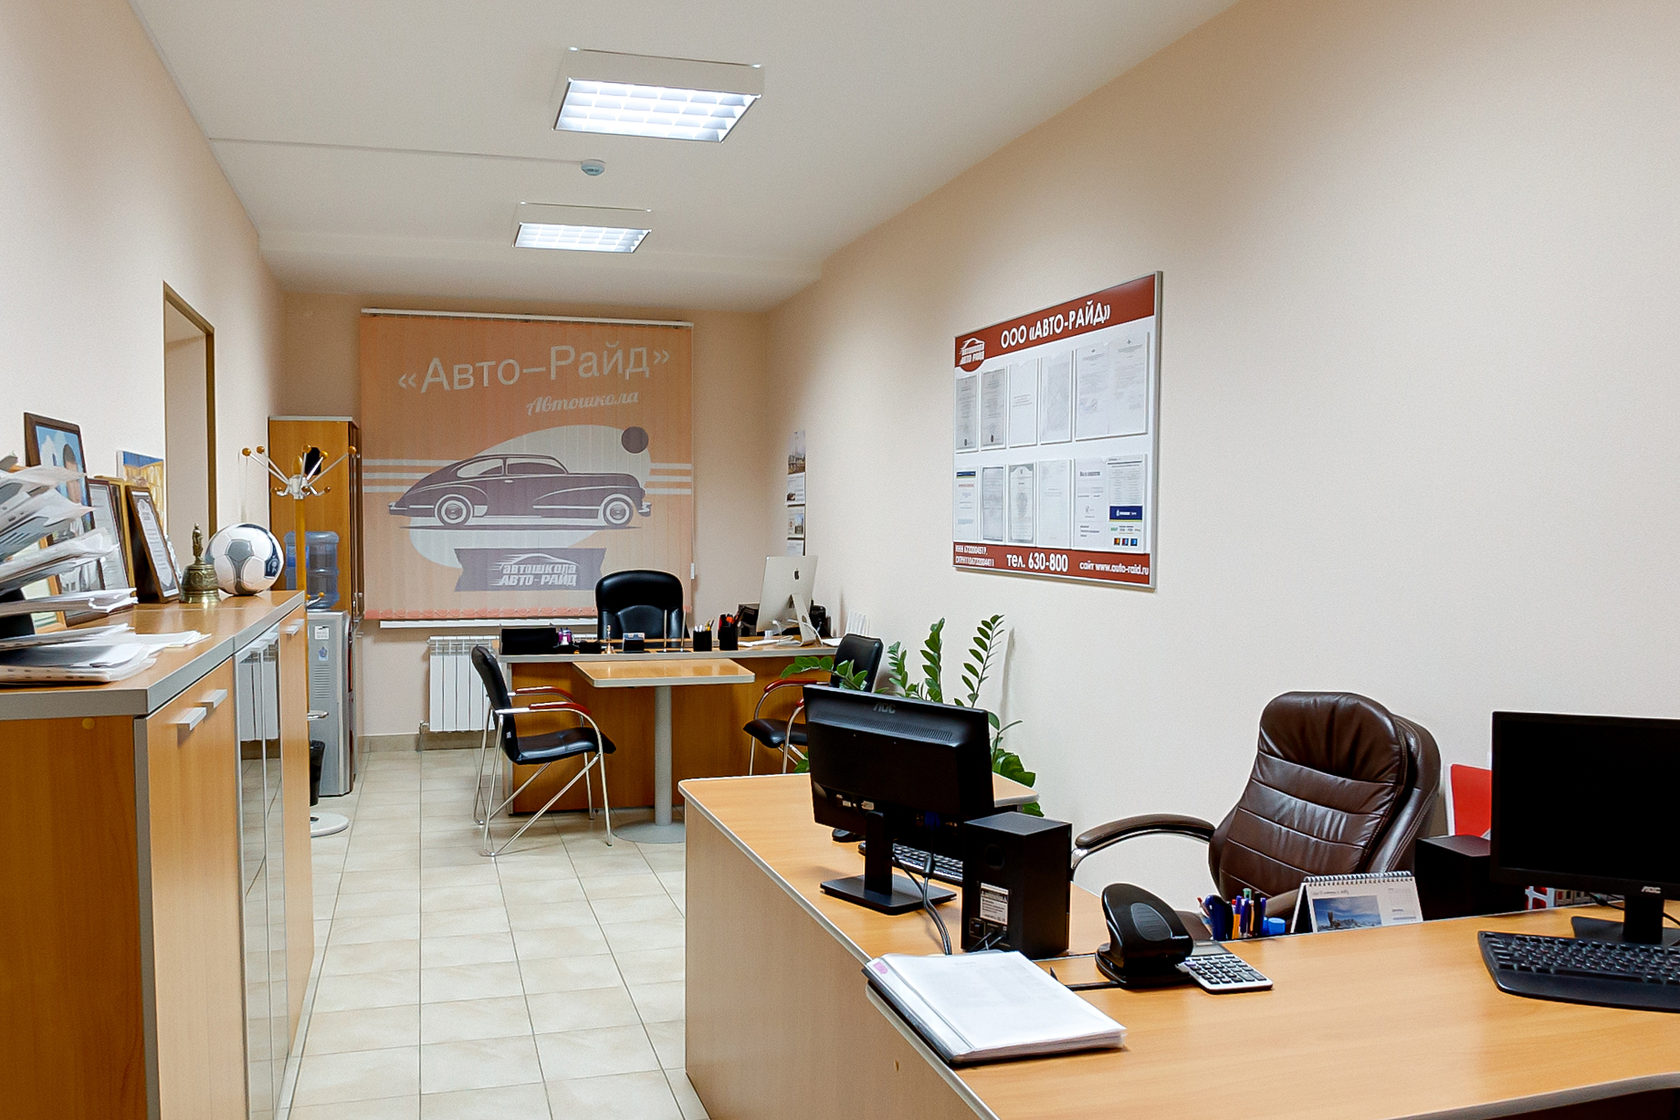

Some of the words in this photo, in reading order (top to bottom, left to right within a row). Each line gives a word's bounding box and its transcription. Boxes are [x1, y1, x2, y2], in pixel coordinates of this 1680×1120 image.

[1001, 325, 1027, 348] ООО
[1029, 300, 1110, 340] «АВТО-РАЙД»
[526, 391, 639, 416] Автошкола
[1006, 554, 1026, 568] тел.
[1028, 552, 1069, 572] 630-800
[499, 573, 578, 587] АВТО-РАЙД
[1641, 885, 1661, 894] AOC
